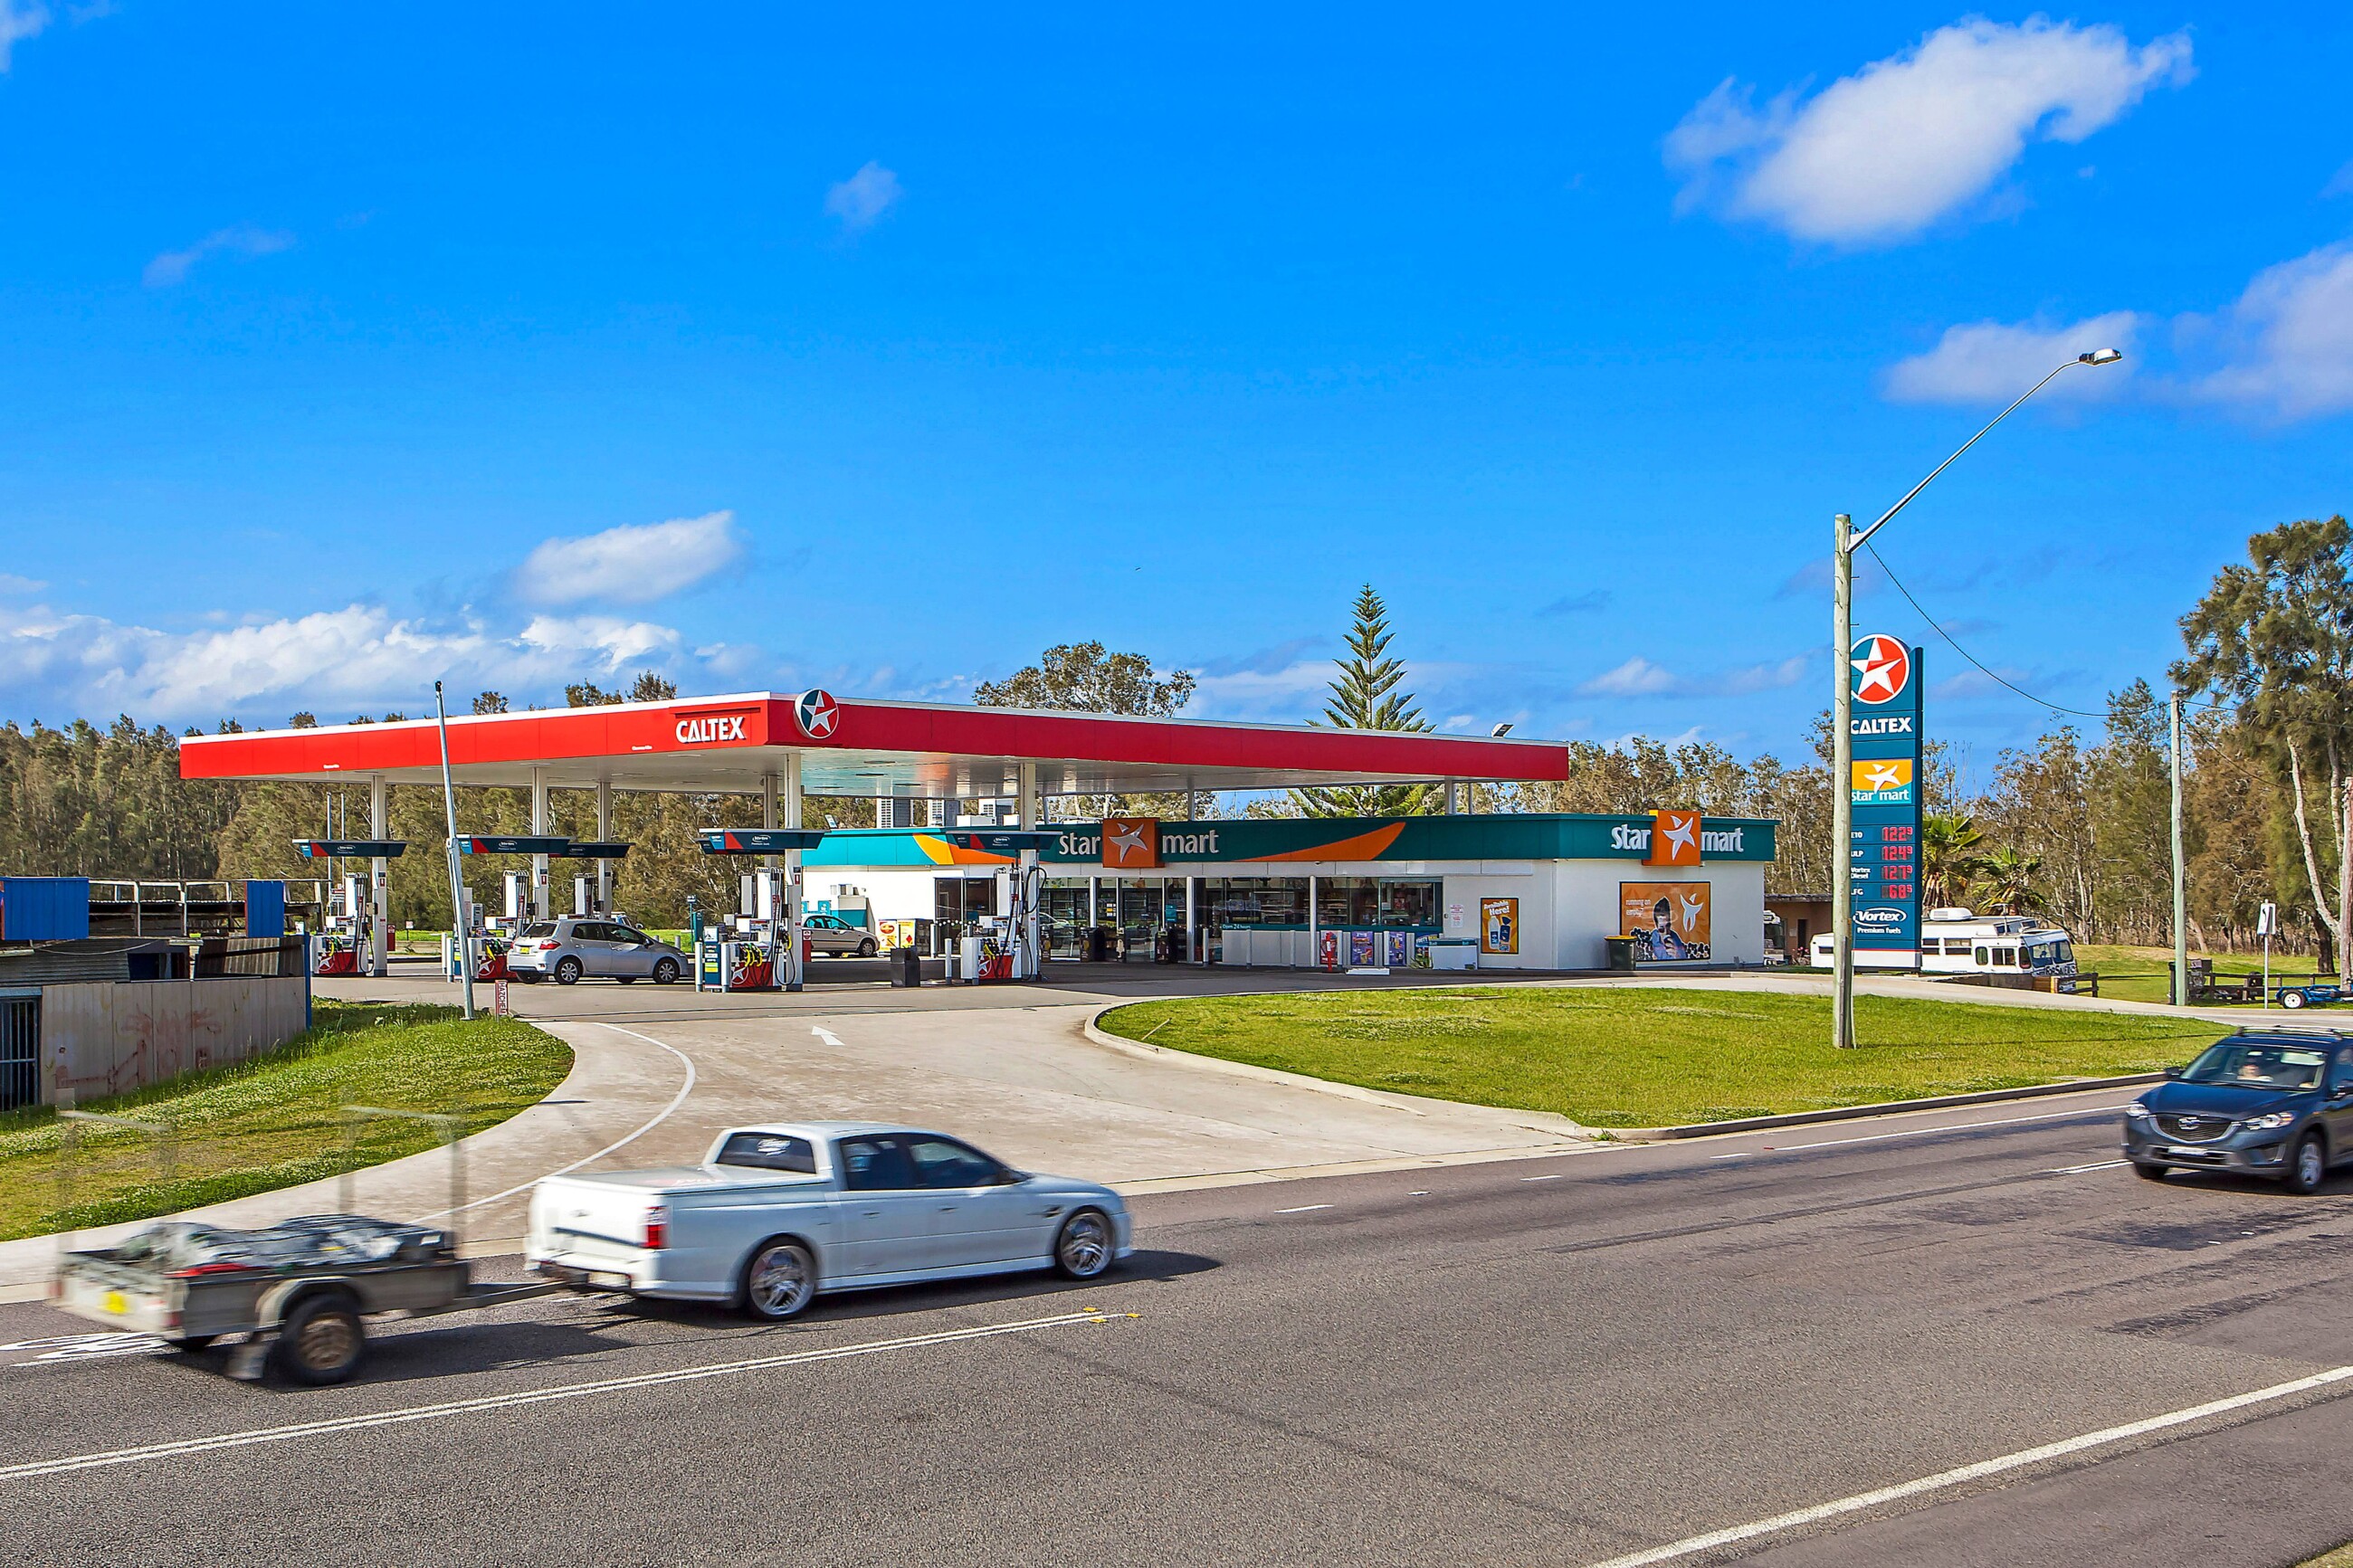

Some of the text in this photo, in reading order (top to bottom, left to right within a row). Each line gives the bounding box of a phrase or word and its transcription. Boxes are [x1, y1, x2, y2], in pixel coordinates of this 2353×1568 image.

[675, 717, 746, 744] CALTEX
[1850, 717, 1912, 735] CALTEX
[1851, 789, 1910, 802] star mart
[1058, 829, 1220, 856] star mart
[1611, 823, 1745, 852] star mart
[1855, 910, 1901, 922] Vortex
